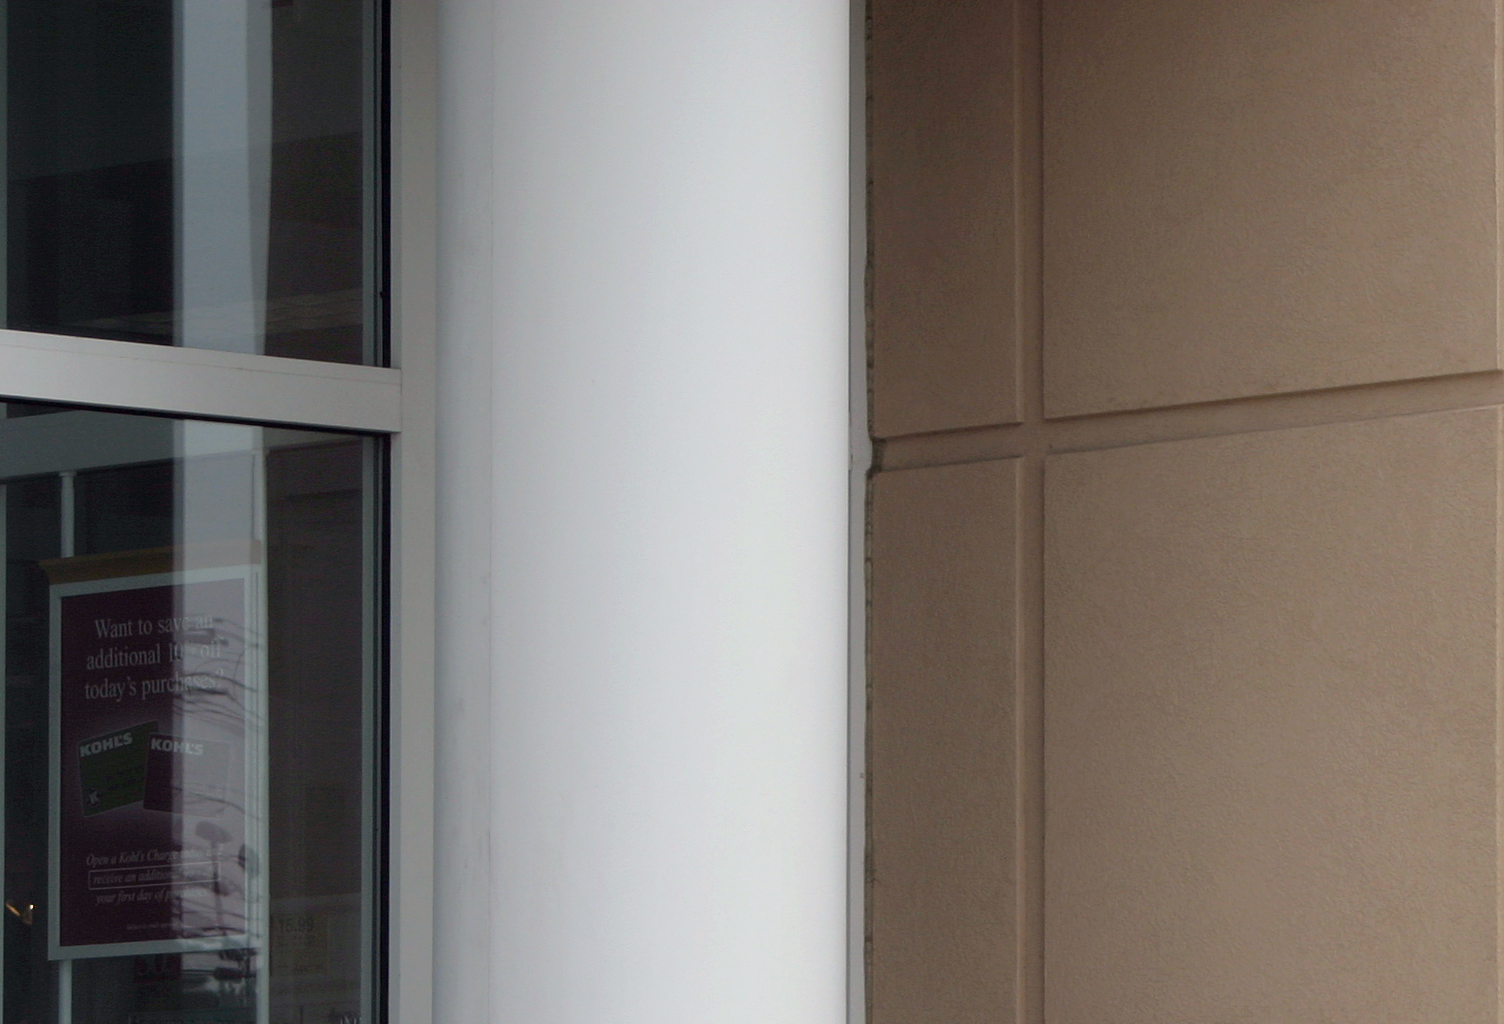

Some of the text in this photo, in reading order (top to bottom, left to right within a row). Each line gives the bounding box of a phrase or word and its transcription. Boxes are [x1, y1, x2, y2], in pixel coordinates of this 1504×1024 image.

[95, 618, 133, 638] Want
[138, 618, 152, 635] to
[158, 617, 190, 633] save
[86, 643, 161, 670] additional
[85, 676, 137, 702] today's
[80, 732, 134, 758] KOHL'S
[151, 737, 204, 756] KOHL'S
